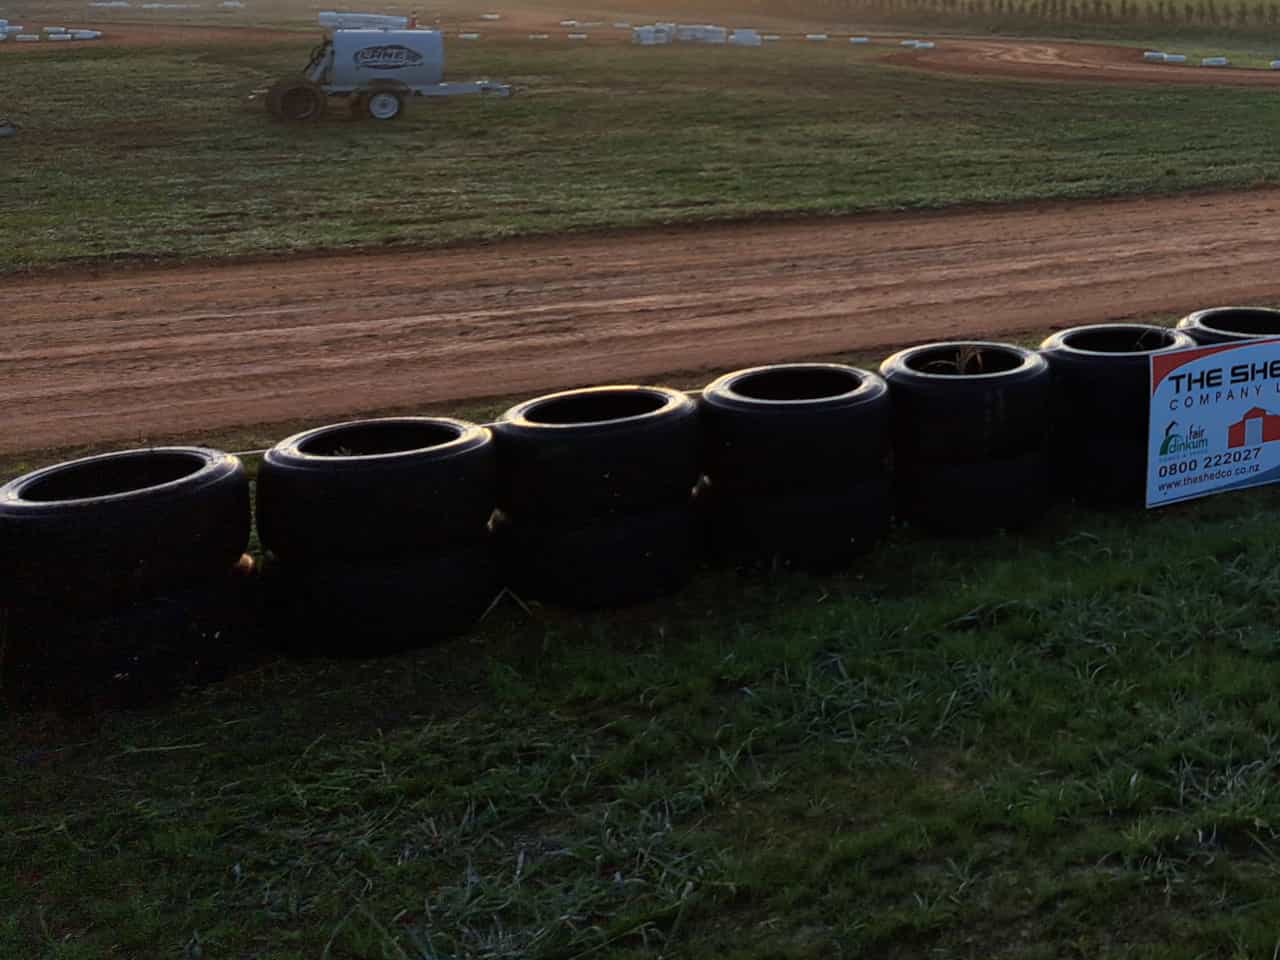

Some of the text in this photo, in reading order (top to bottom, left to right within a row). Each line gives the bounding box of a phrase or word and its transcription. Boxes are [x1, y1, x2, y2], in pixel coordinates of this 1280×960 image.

[1168, 368, 1223, 394] THE
[1169, 384, 1263, 411] COMPANY
[1169, 433, 1209, 454] dinkum
[1188, 424, 1206, 440] fair
[1159, 459, 1198, 478] 0800
[1203, 447, 1262, 468] 222027
[1158, 463, 1260, 491] www.theshedco.co.nz
